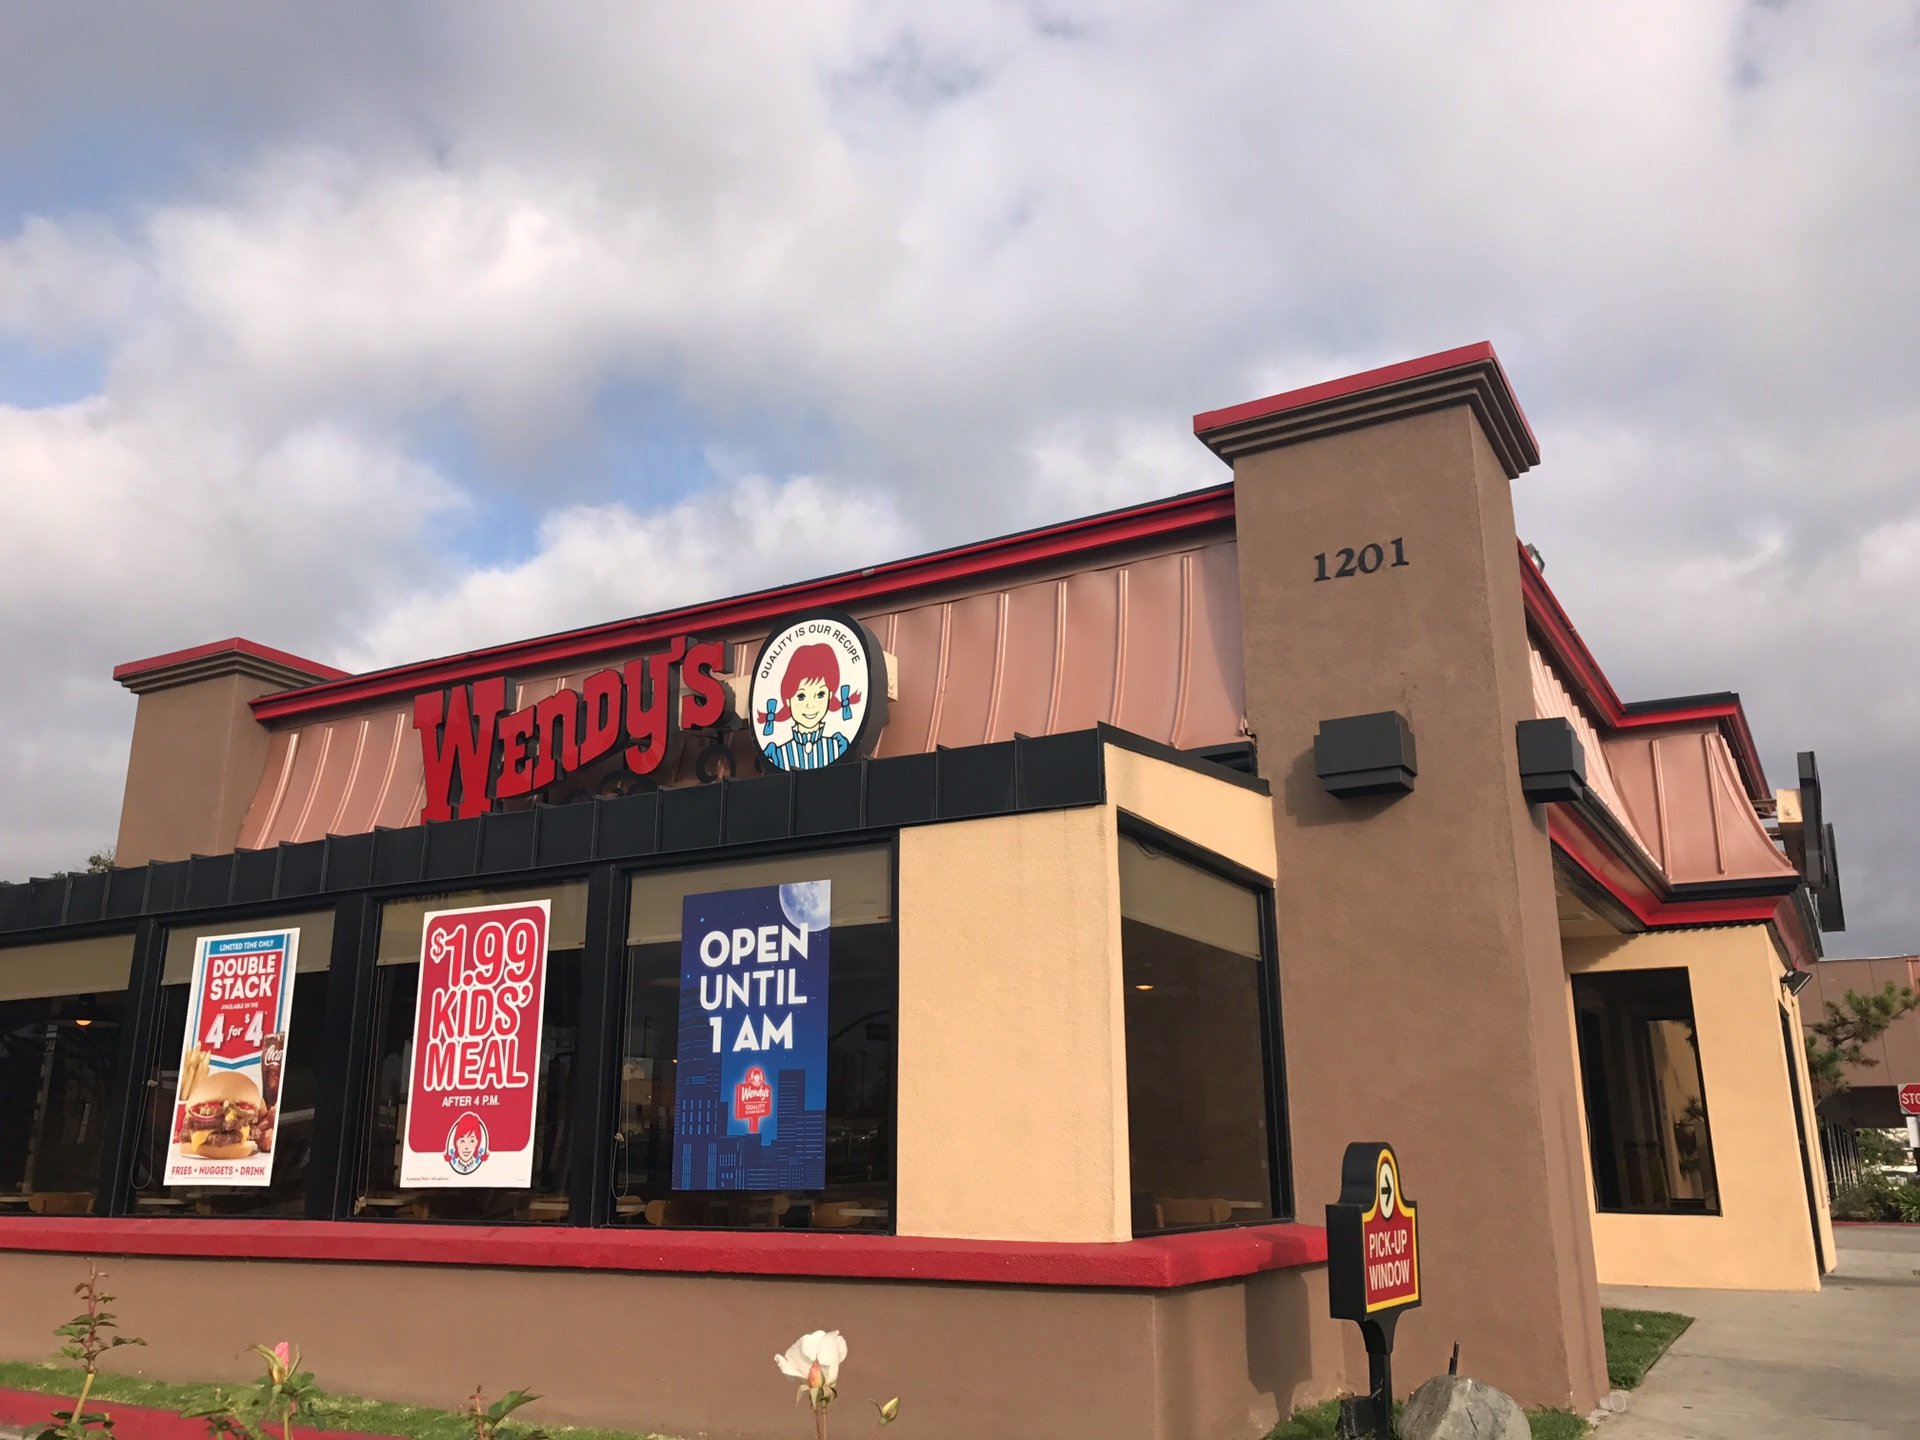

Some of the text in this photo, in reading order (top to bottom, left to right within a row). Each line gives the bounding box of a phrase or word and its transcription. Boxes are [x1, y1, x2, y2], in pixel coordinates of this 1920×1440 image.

[1313, 536, 1410, 582] 1201
[761, 624, 861, 679] QUALITY IS OUR RECIPE
[219, 939, 275, 952] LIMITED TIME ONLY
[430, 918, 538, 990] $1.99
[699, 922, 809, 968] OPEN
[212, 954, 277, 978] DOUBLE
[209, 974, 275, 1001] STACK
[700, 968, 808, 1011] UNTIL
[429, 981, 534, 1042] KIDS'
[204, 1013, 226, 1049] 4
[226, 1025, 244, 1041] for
[709, 1011, 794, 1053] 1 AM
[423, 1034, 529, 1092] MEAL
[441, 1095, 501, 1108] AFTER 4 P.M.
[745, 1103, 766, 1111] QUALITY
[171, 1166, 192, 1176] FRIES
[199, 1166, 234, 1176] NUGGETS
[240, 1166, 265, 1176] DRINK
[1369, 1229, 1408, 1259] PICK-UP
[1369, 1259, 1410, 1291] WINDOW
